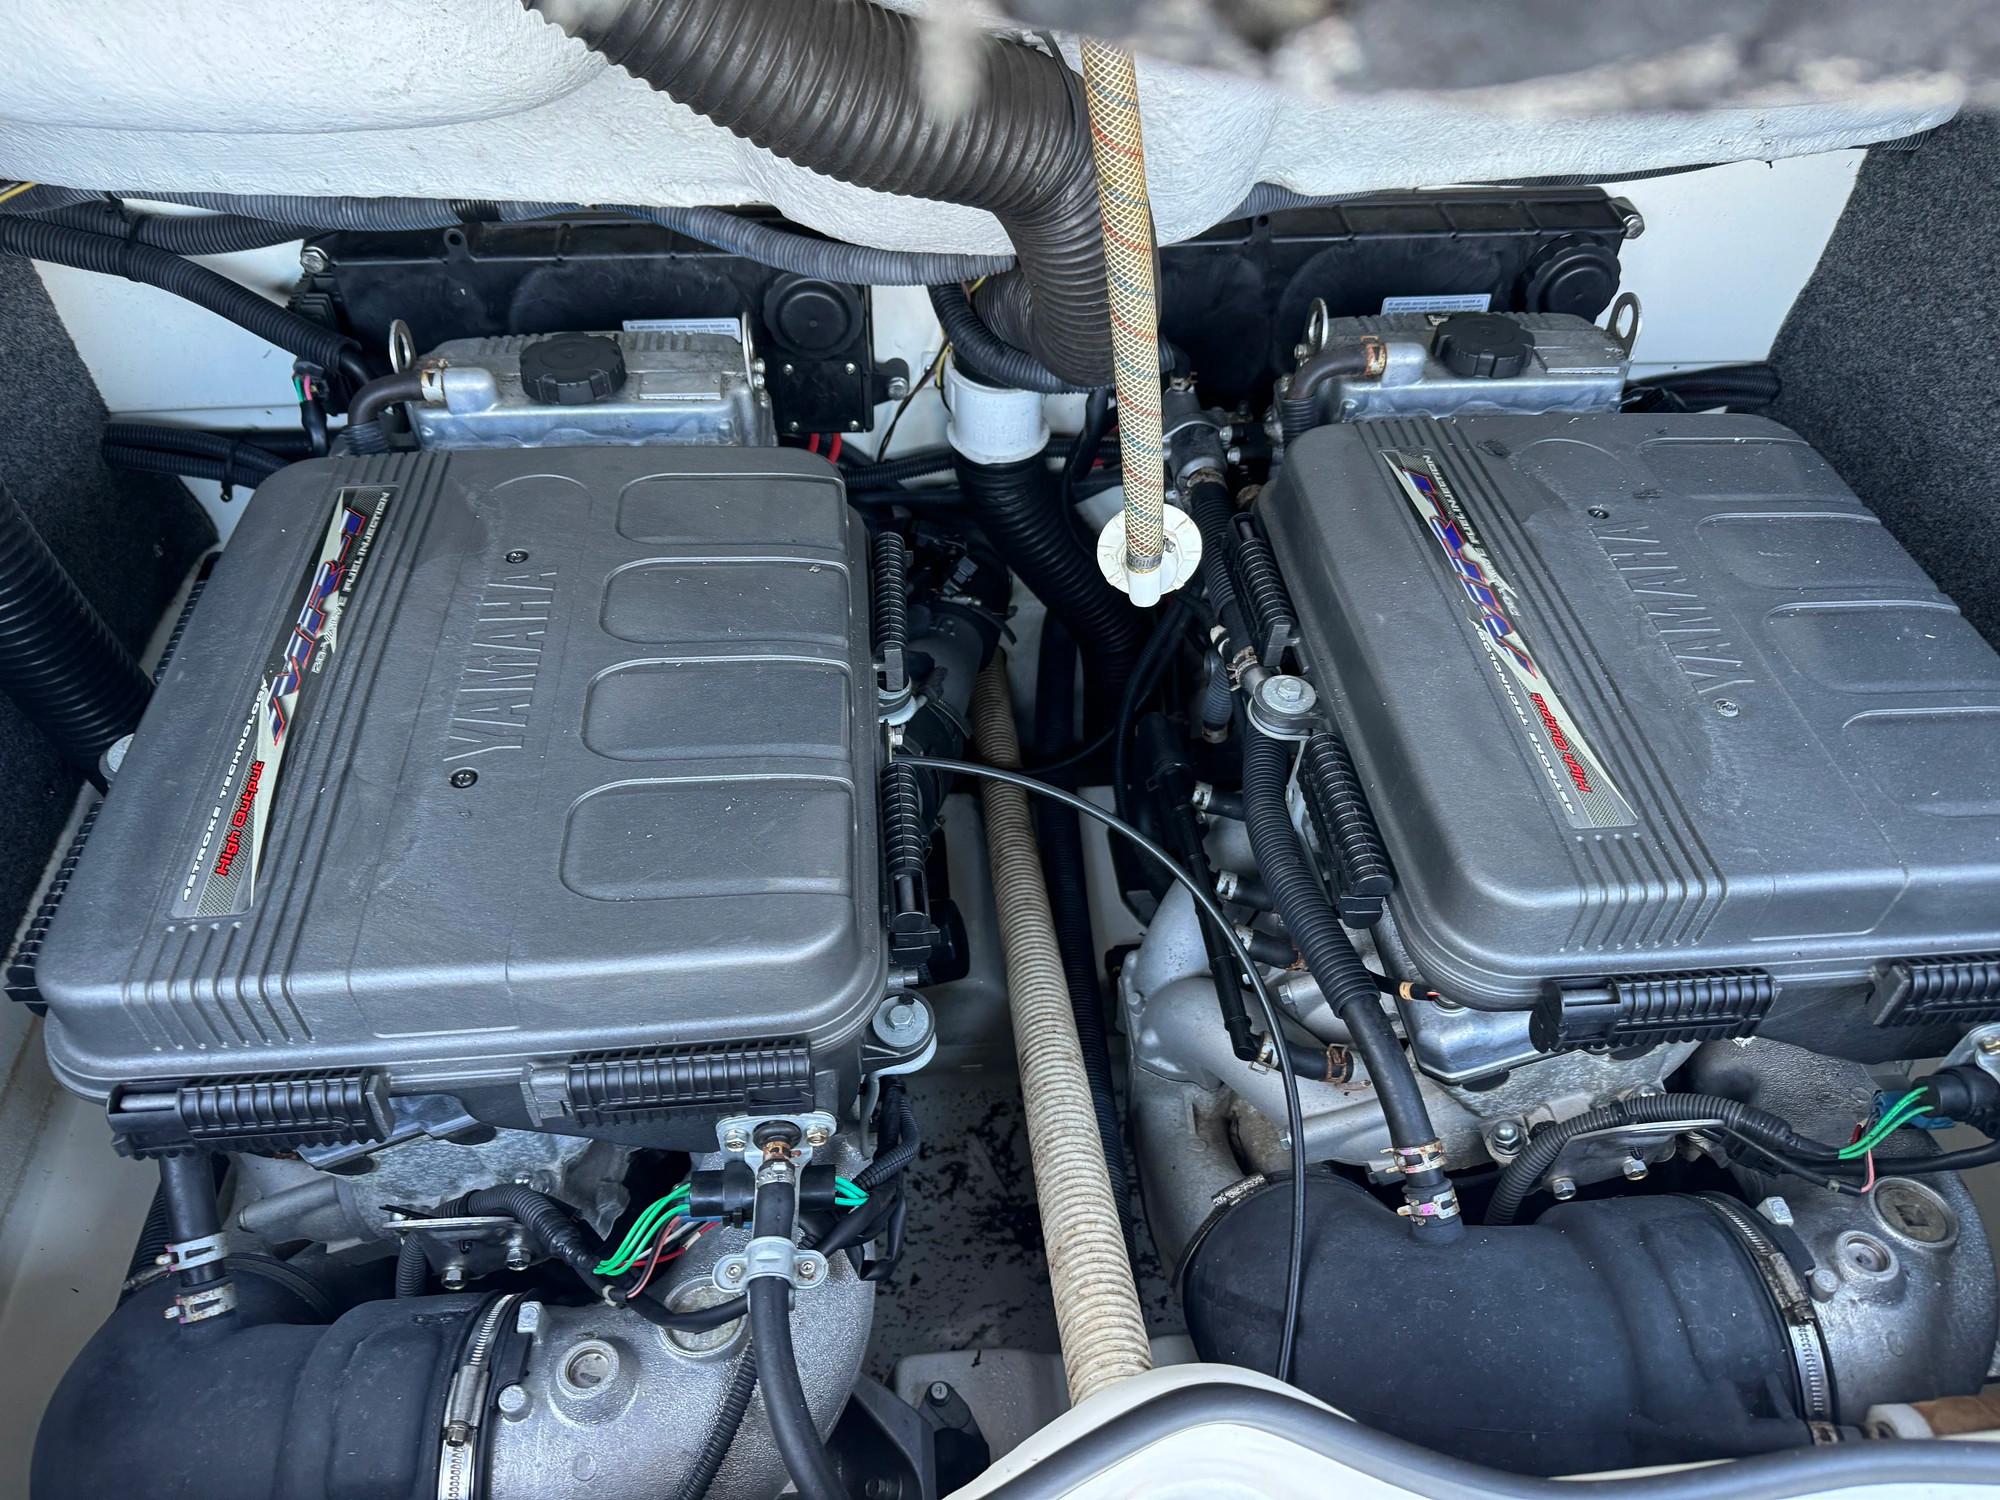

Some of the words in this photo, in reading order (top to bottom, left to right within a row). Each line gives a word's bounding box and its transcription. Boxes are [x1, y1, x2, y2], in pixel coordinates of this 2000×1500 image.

[1590, 519, 1755, 694] YAMAHA
[443, 566, 558, 762] YAMAHA
[1470, 621, 1529, 726] TECHNOLOGY
[1528, 731, 1575, 815] 4STROKE
[1530, 692, 1569, 751] Output
[1562, 752, 1592, 793] High
[183, 806, 222, 901] 4STROKE
[219, 682, 268, 799] TECHNOLOGY
[214, 830, 242, 877] High
[231, 760, 266, 828] Output
